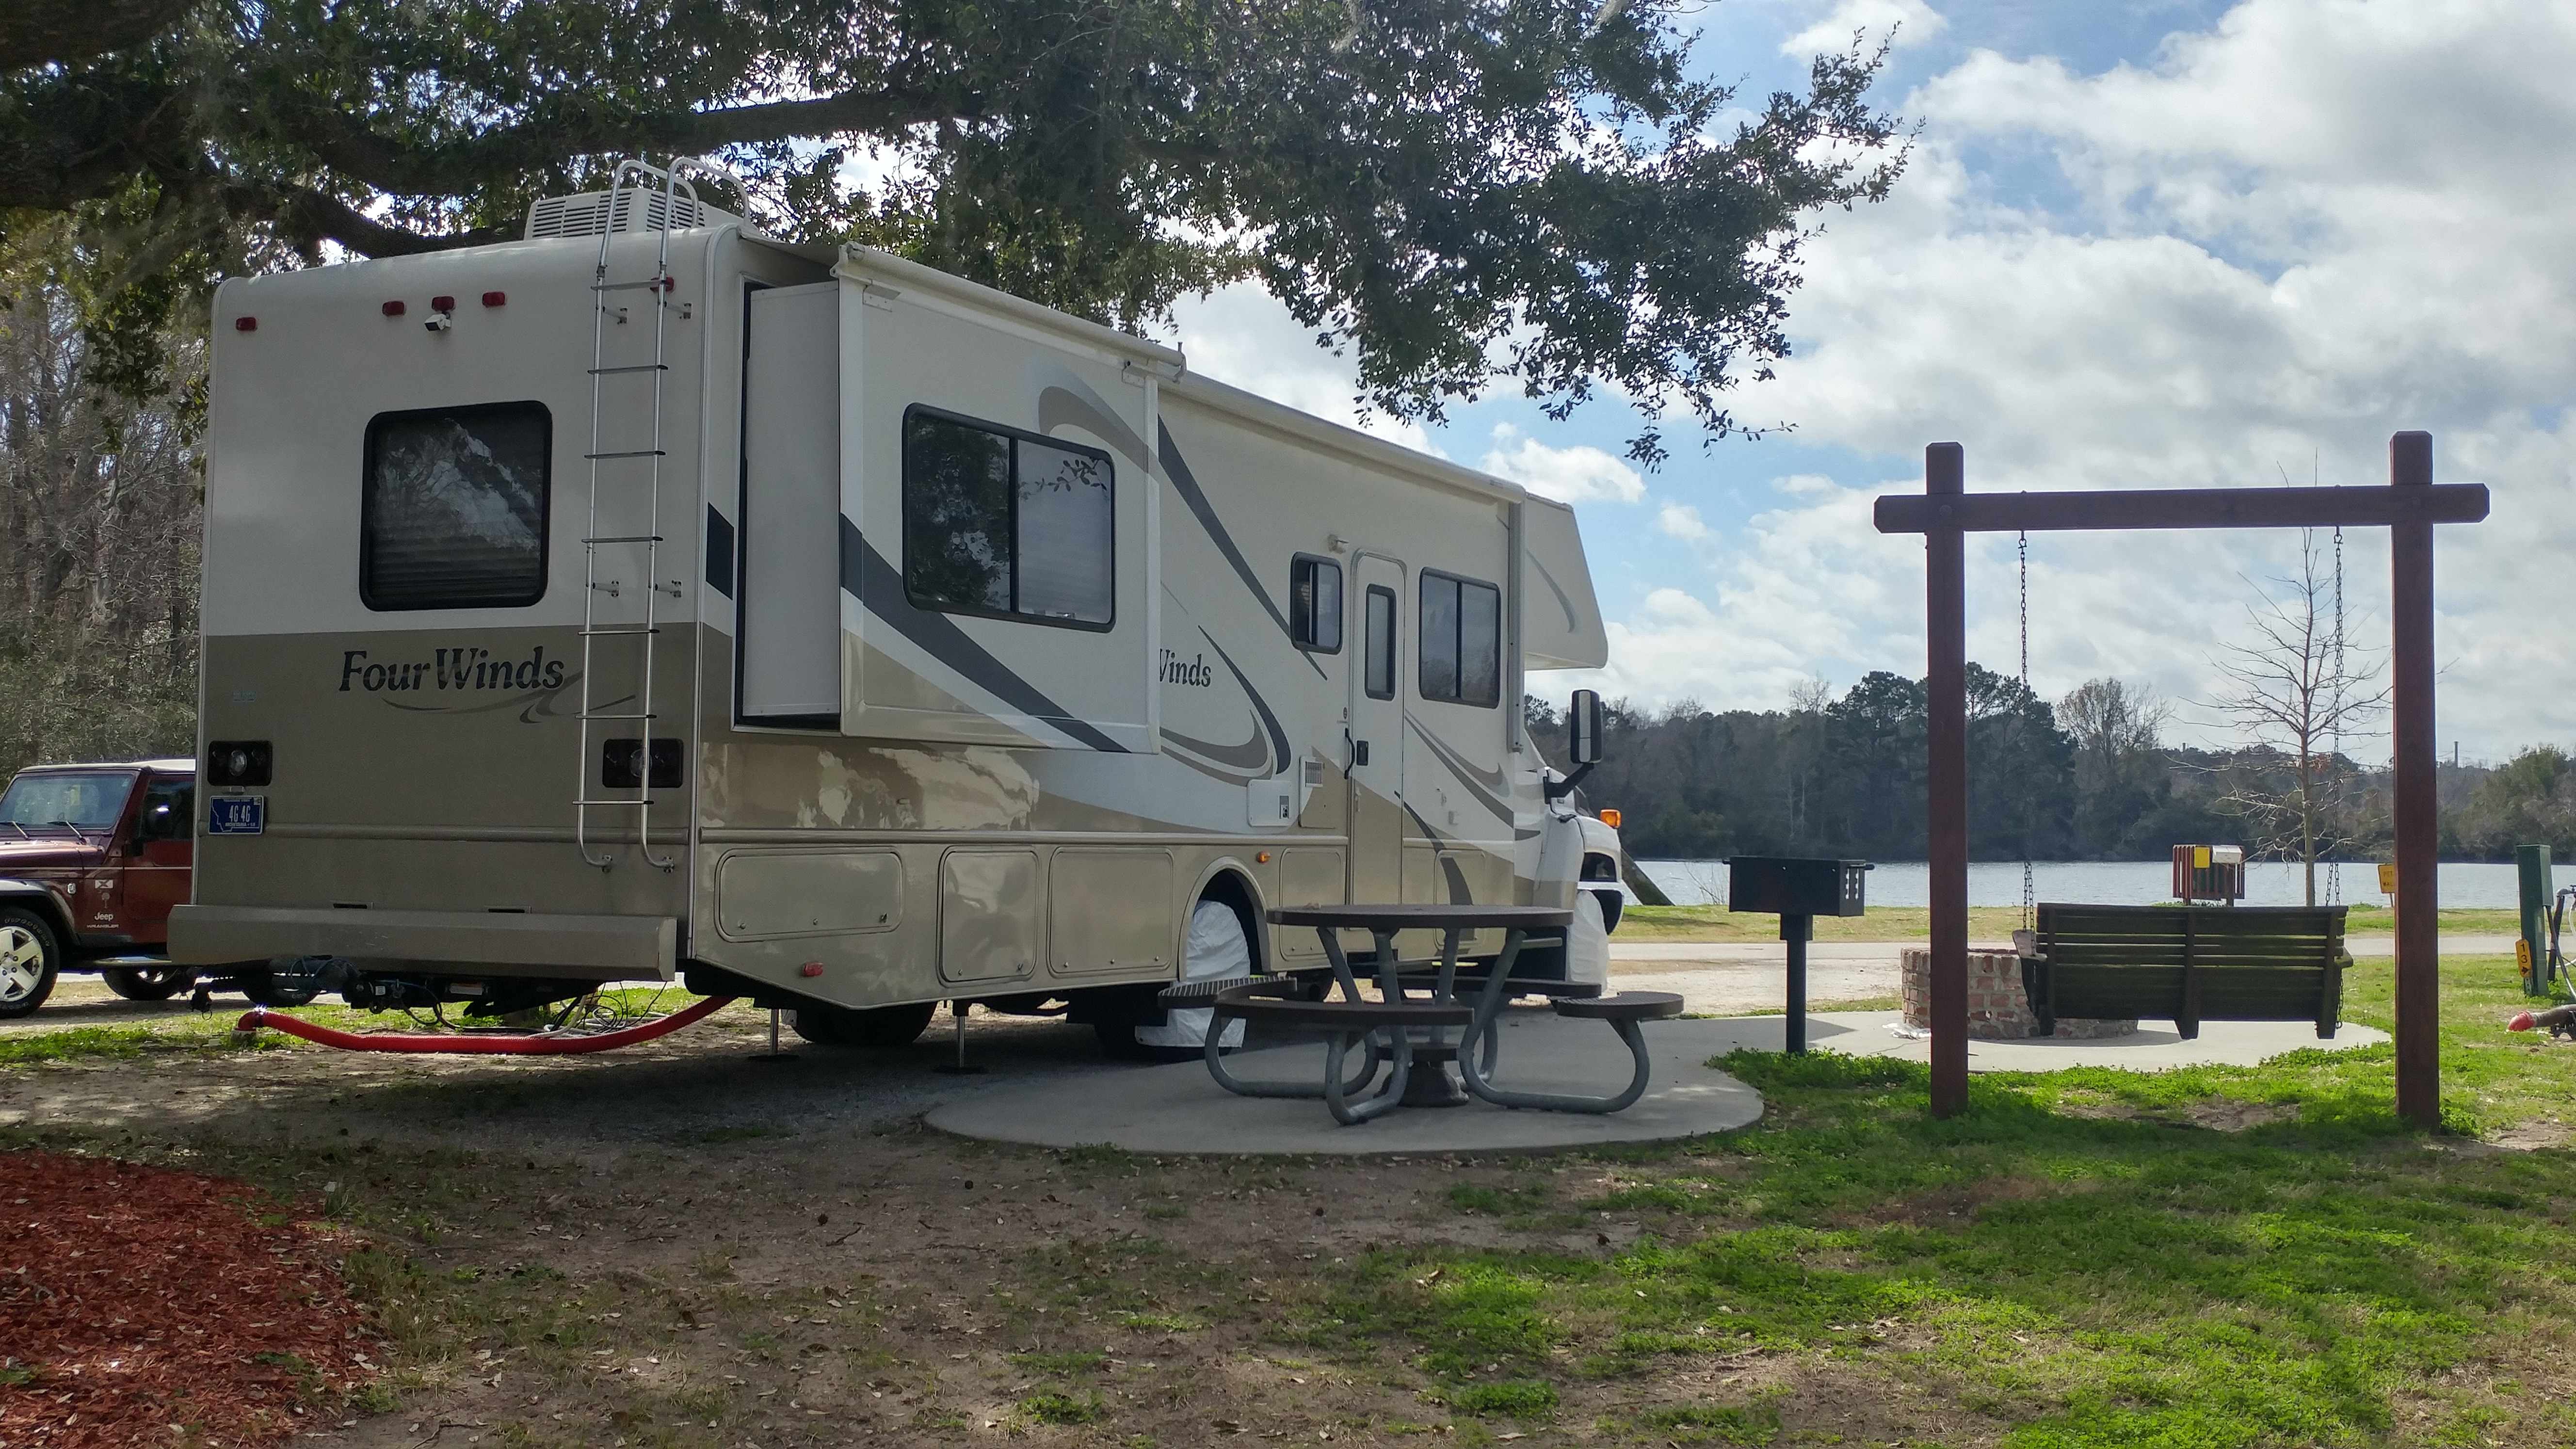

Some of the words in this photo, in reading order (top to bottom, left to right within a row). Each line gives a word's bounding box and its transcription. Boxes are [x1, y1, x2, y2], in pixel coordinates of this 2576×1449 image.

[339, 650, 431, 691] Four
[435, 645, 564, 690] Winds
[94, 912, 113, 921] Jeep
